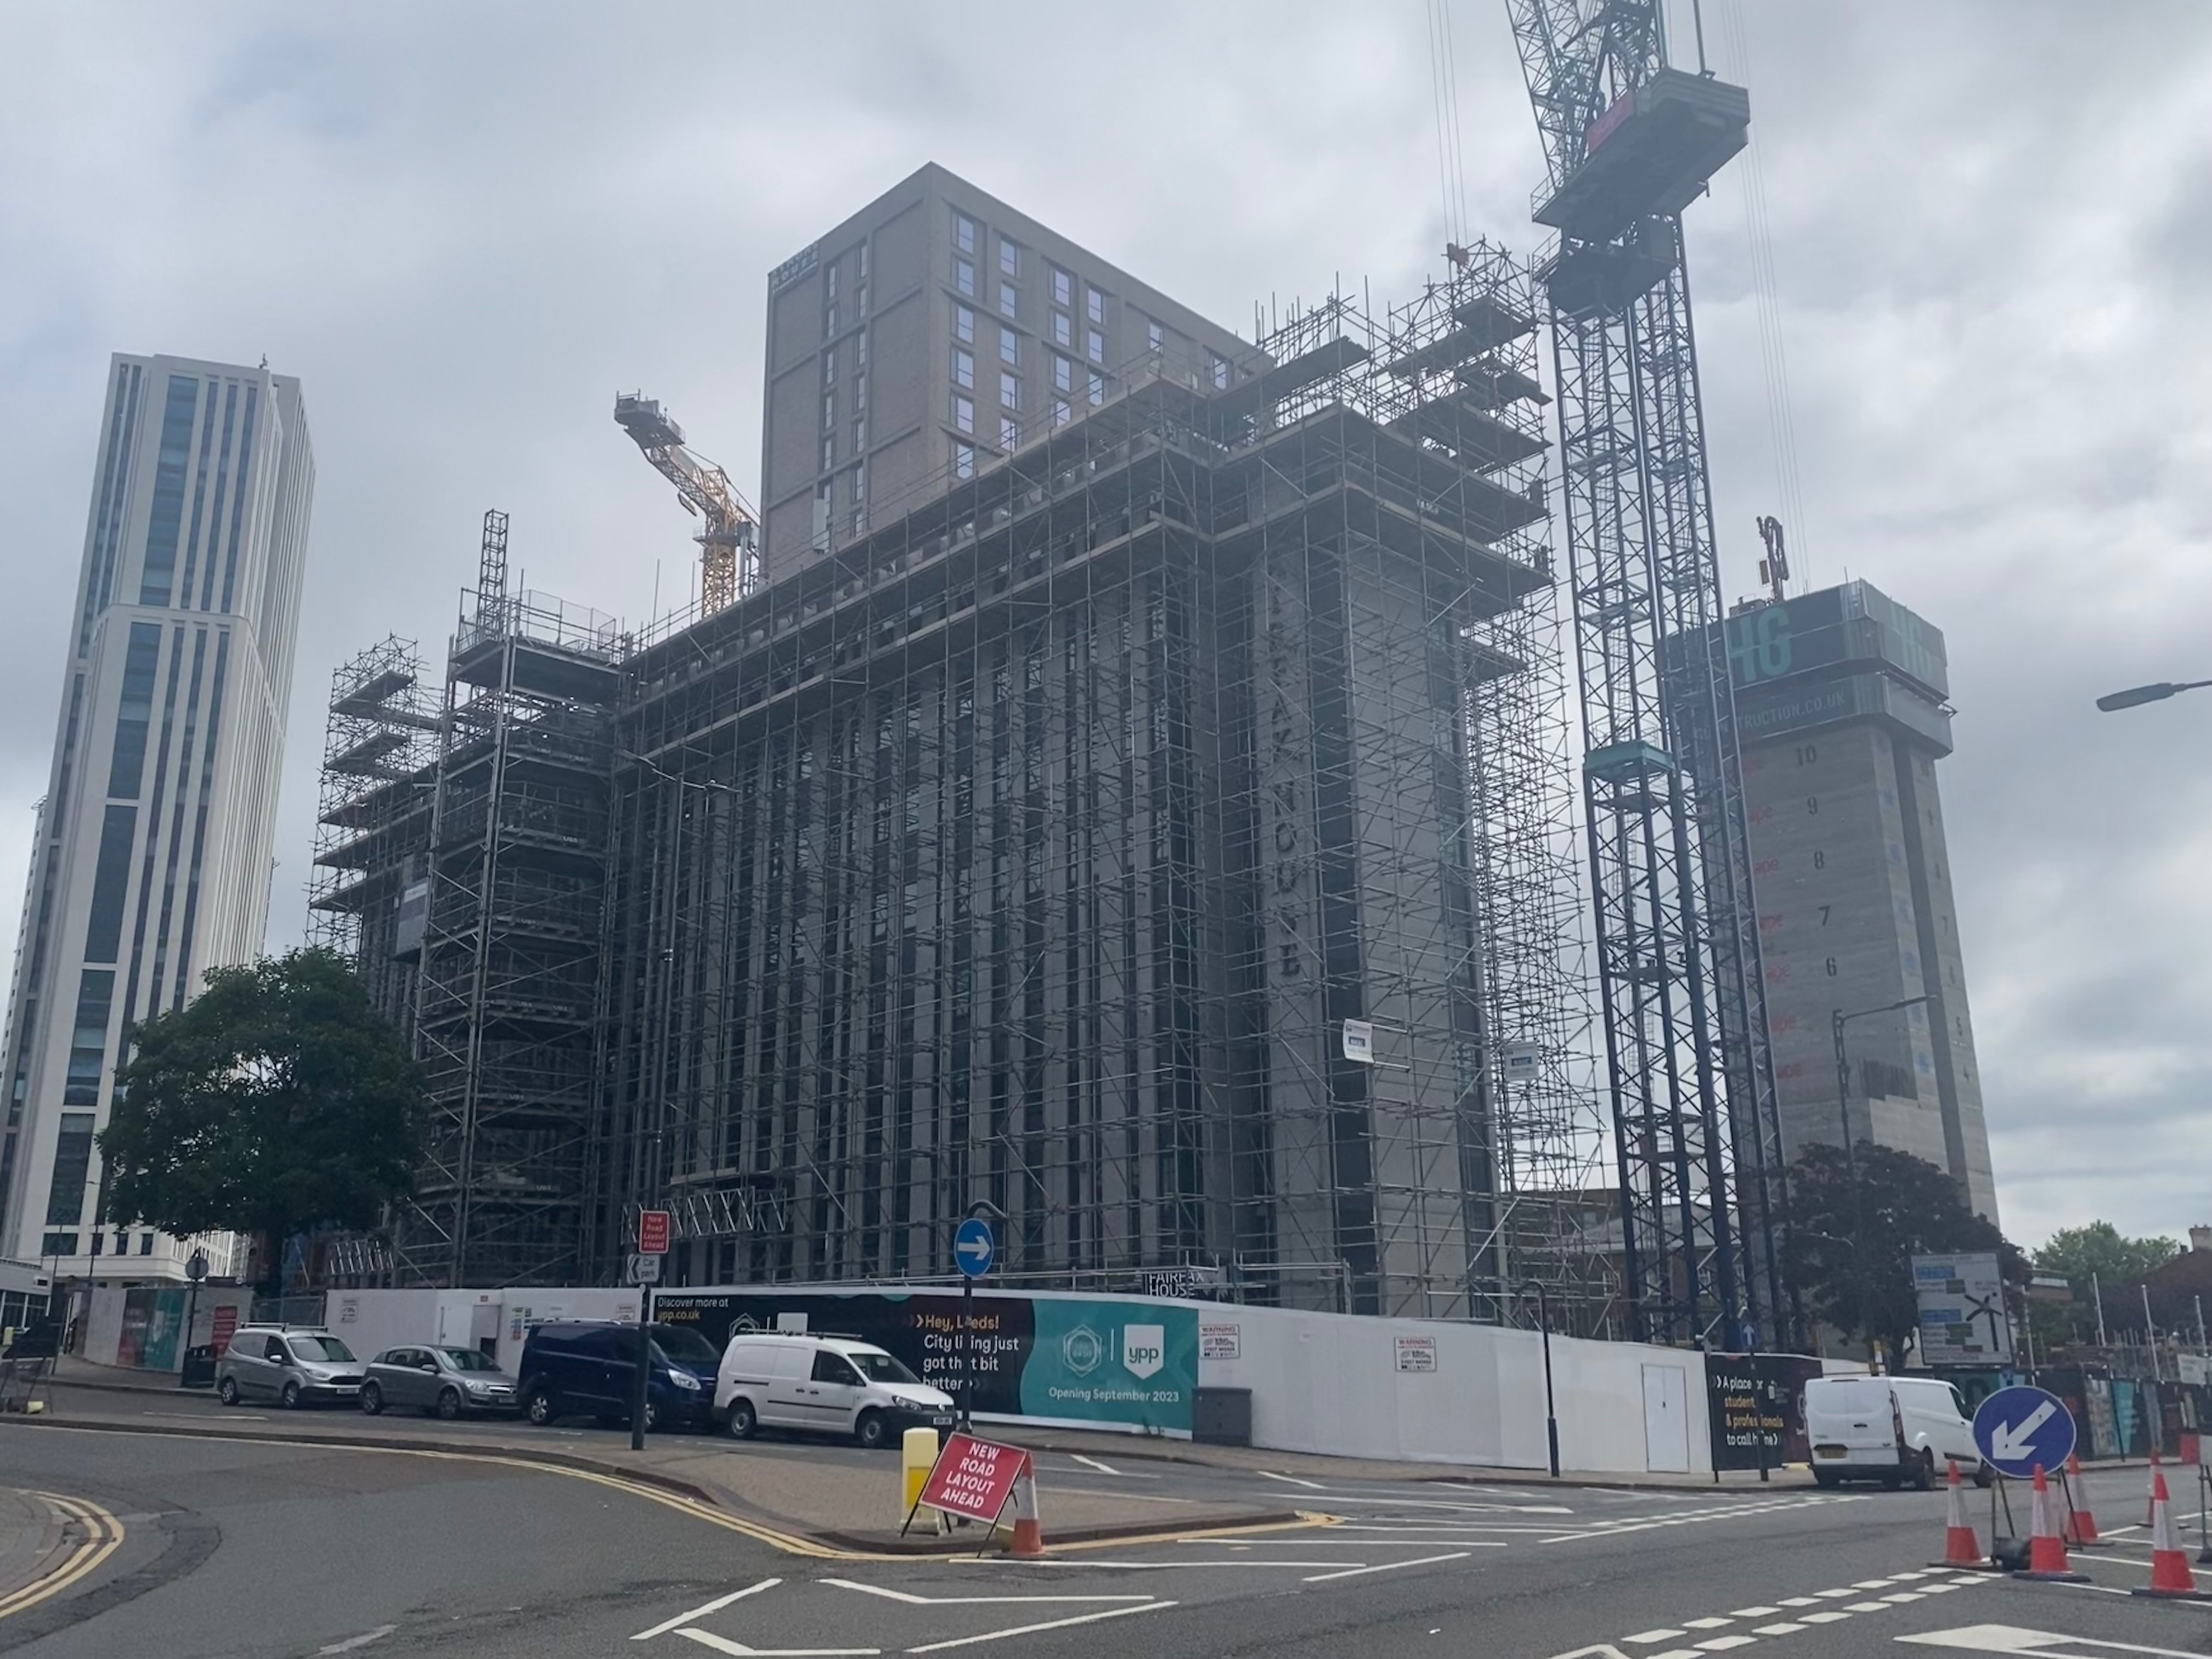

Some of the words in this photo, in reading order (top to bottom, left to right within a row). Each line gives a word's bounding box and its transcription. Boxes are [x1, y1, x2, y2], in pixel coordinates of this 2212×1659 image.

[1795, 745, 1817, 766] 10
[1807, 797, 1818, 815] 9
[1814, 850, 1825, 870] 8
[1818, 905, 1831, 926] 7
[1826, 956, 1837, 977] 6
[641, 1269, 655, 1278] park
[1149, 1272, 1204, 1284] FAIRFAX
[1150, 1284, 1195, 1297] HOUSE
[658, 1297, 693, 1307] Discover
[695, 1299, 717, 1307] more
[719, 1298, 729, 1307] at
[658, 1310, 700, 1322] ypp.co.uk
[925, 1314, 953, 1332] Hey,
[957, 1315, 999, 1329] Leds!
[924, 1334, 952, 1353] City
[955, 1335, 991, 1354] liing
[992, 1335, 1019, 1354] just
[1129, 1347, 1159, 1364] ypp
[923, 1357, 945, 1373] got
[949, 1356, 977, 1371] tht
[980, 1357, 999, 1371] bit
[923, 1375, 963, 1390] better
[1723, 1375, 1729, 1389] A
[1730, 1376, 1752, 1392] place
[1048, 1387, 1091, 1402] Opening
[1093, 1389, 1150, 1403] September
[1153, 1391, 1180, 1402] 2023
[1733, 1413, 1784, 1429] profesionals
[1727, 1433, 1735, 1446] to
[1737, 1432, 1752, 1446] call
[1753, 1432, 1773, 1446] hme
[968, 1442, 1000, 1461] NEW
[960, 1457, 995, 1476] ROAD
[945, 1471, 995, 1495] LAYOUT
[940, 1487, 984, 1509] AHEAD
